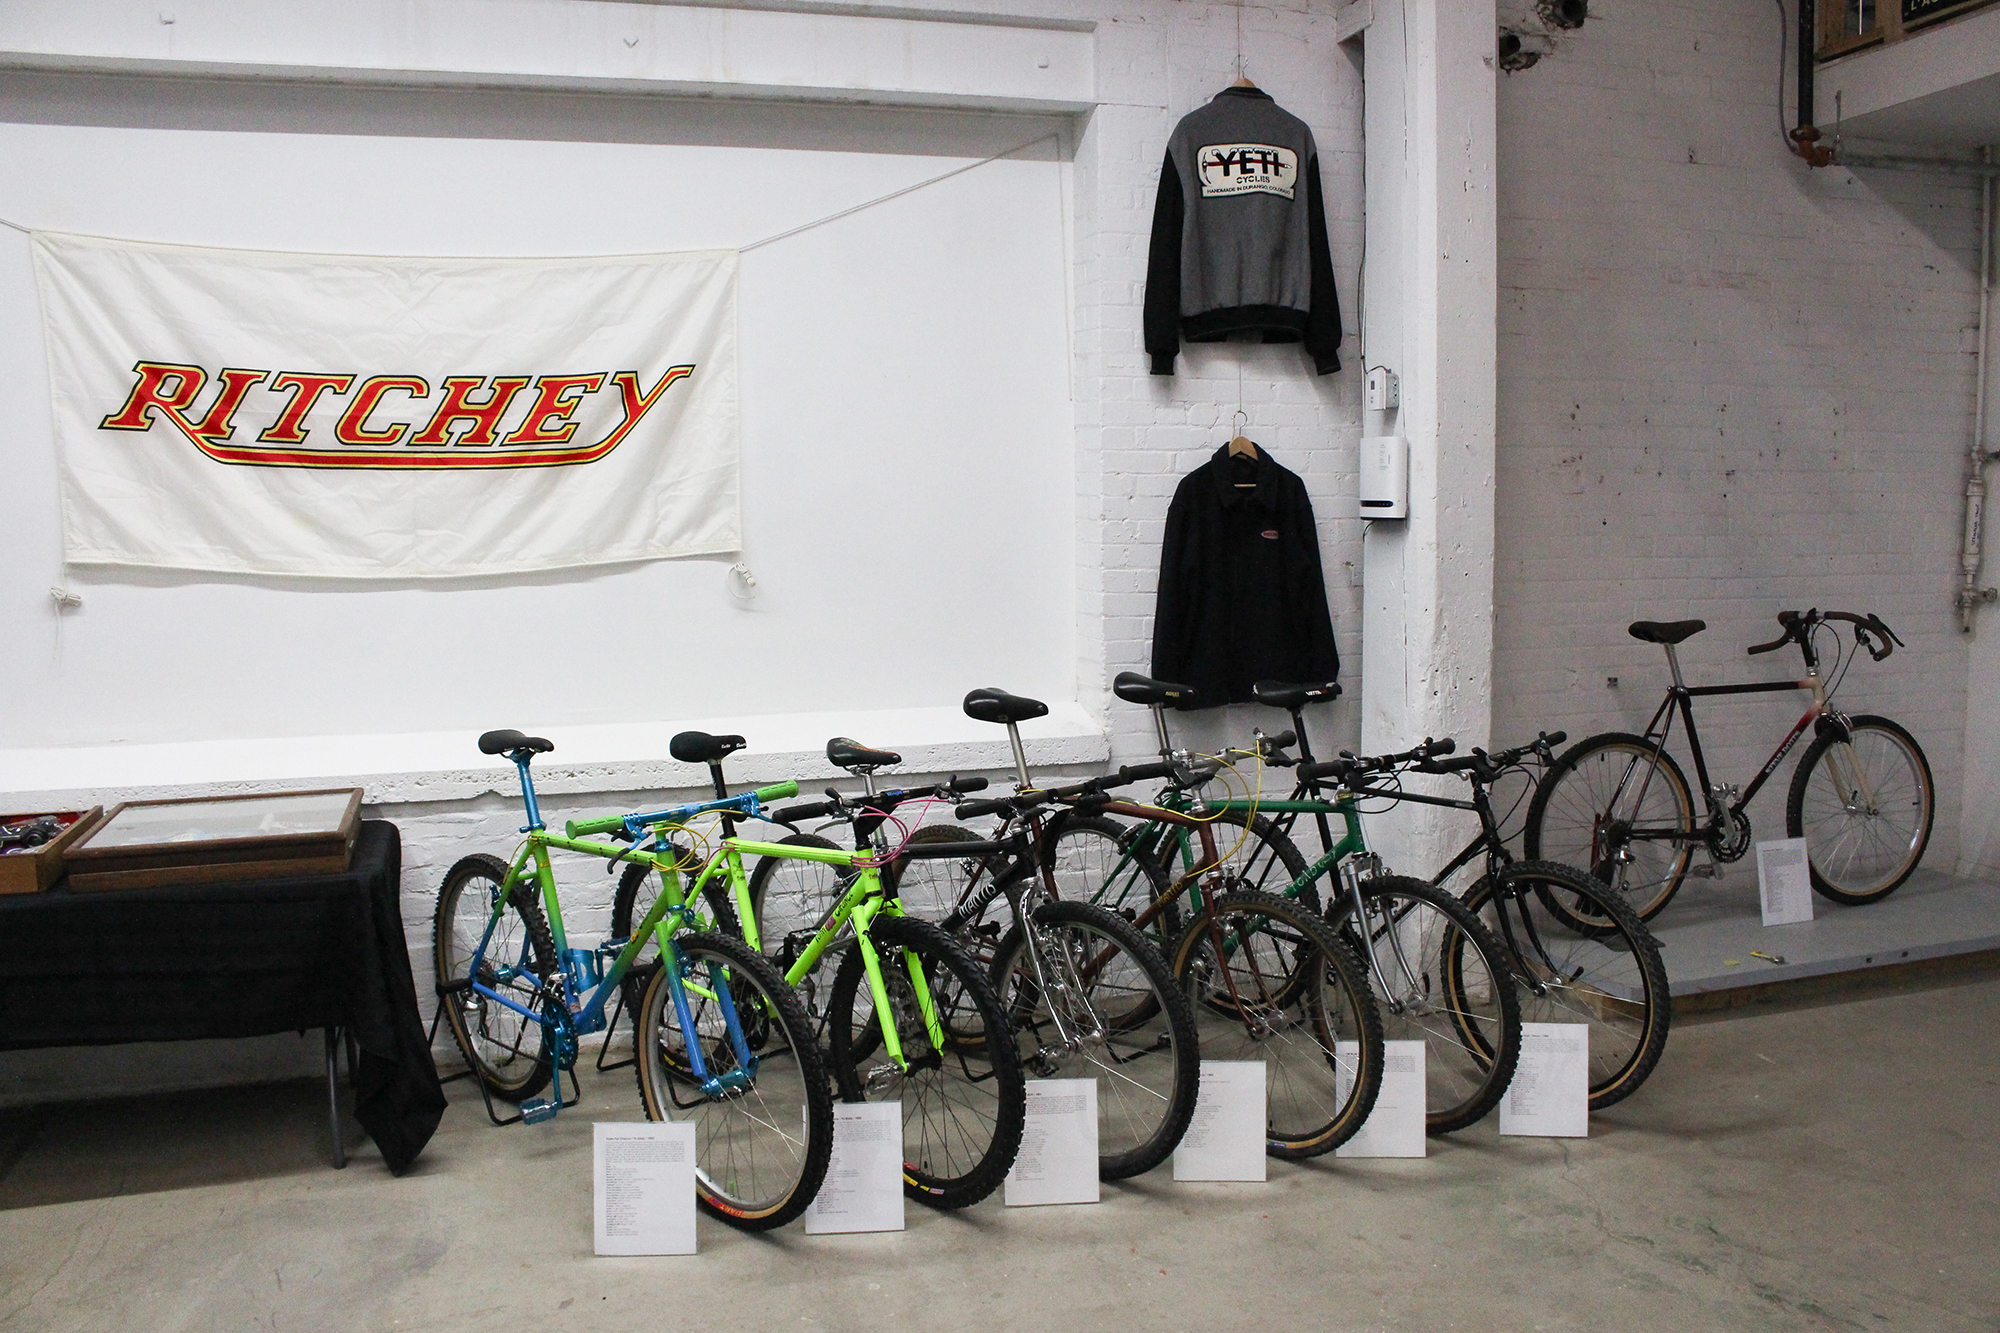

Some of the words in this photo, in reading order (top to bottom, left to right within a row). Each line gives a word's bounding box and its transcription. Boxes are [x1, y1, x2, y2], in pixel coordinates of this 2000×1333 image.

[1212, 147, 1280, 177] YETI
[1206, 186, 1236, 194] HANDMADE
[1236, 175, 1271, 184] CYCLES
[99, 359, 696, 471] RITCHEY
[958, 884, 997, 919] MANTIS
